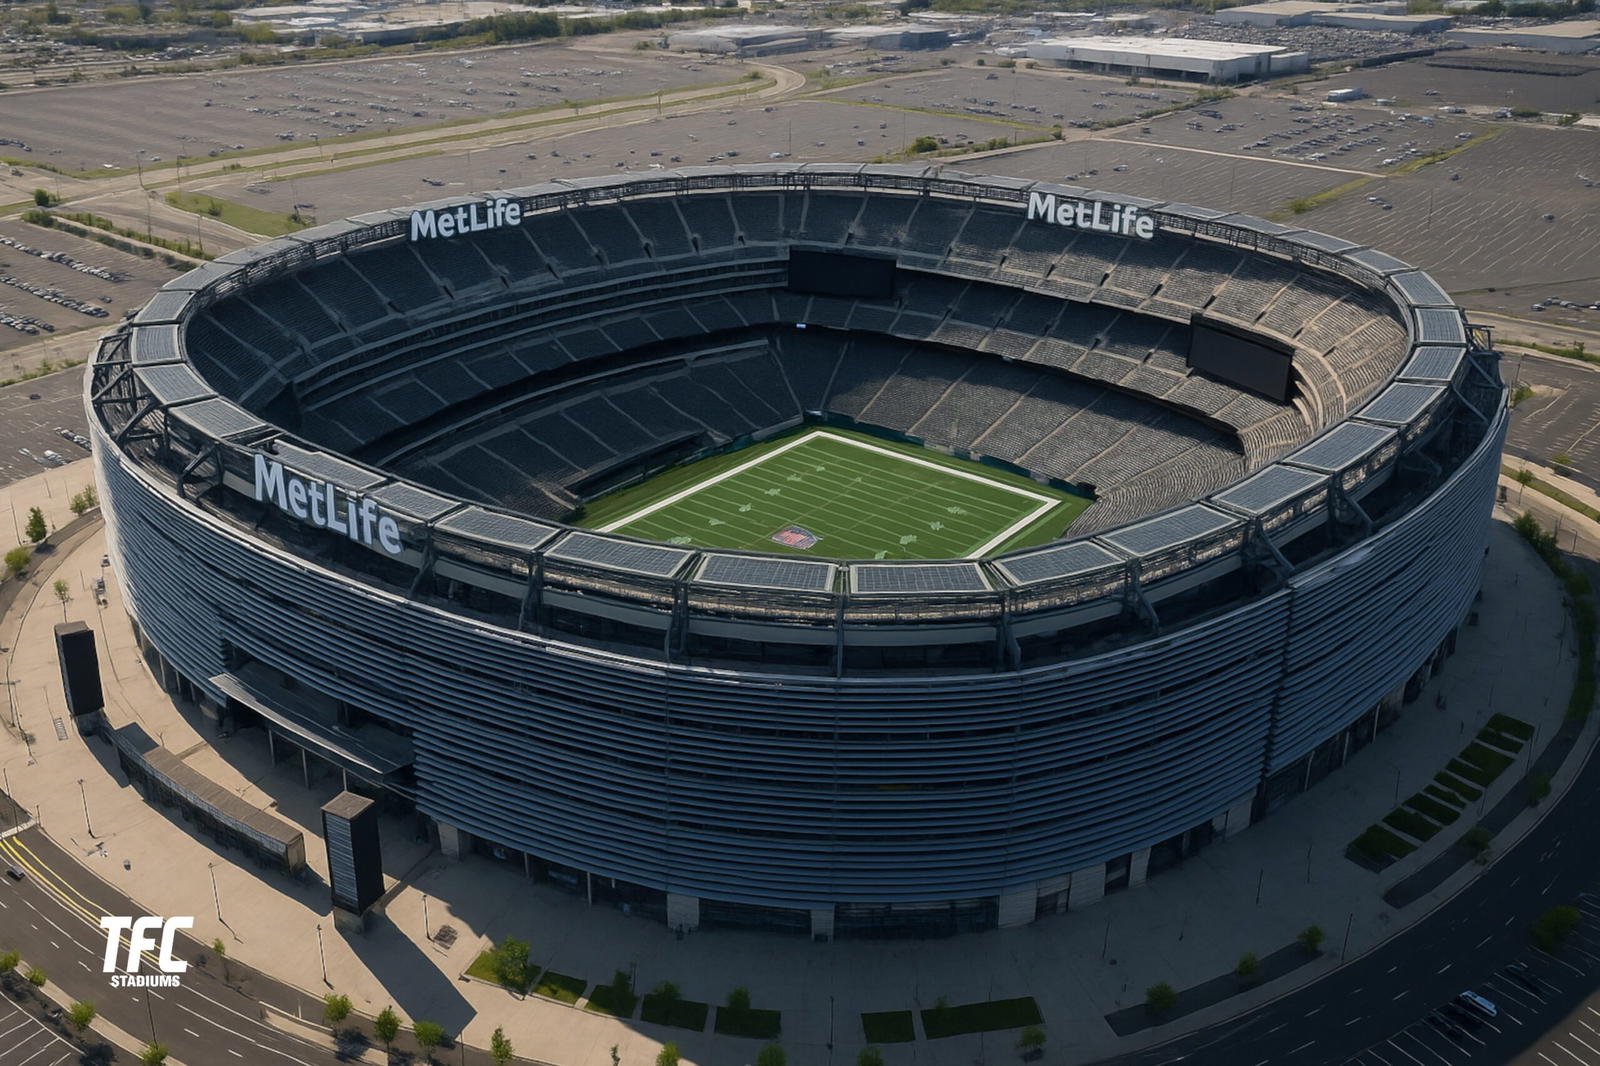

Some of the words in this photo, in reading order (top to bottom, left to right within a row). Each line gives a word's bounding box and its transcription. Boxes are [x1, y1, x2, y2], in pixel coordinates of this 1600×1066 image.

[410, 198, 521, 241] MetLife
[1027, 191, 1154, 239] MetLife
[254, 454, 402, 554] MetLife
